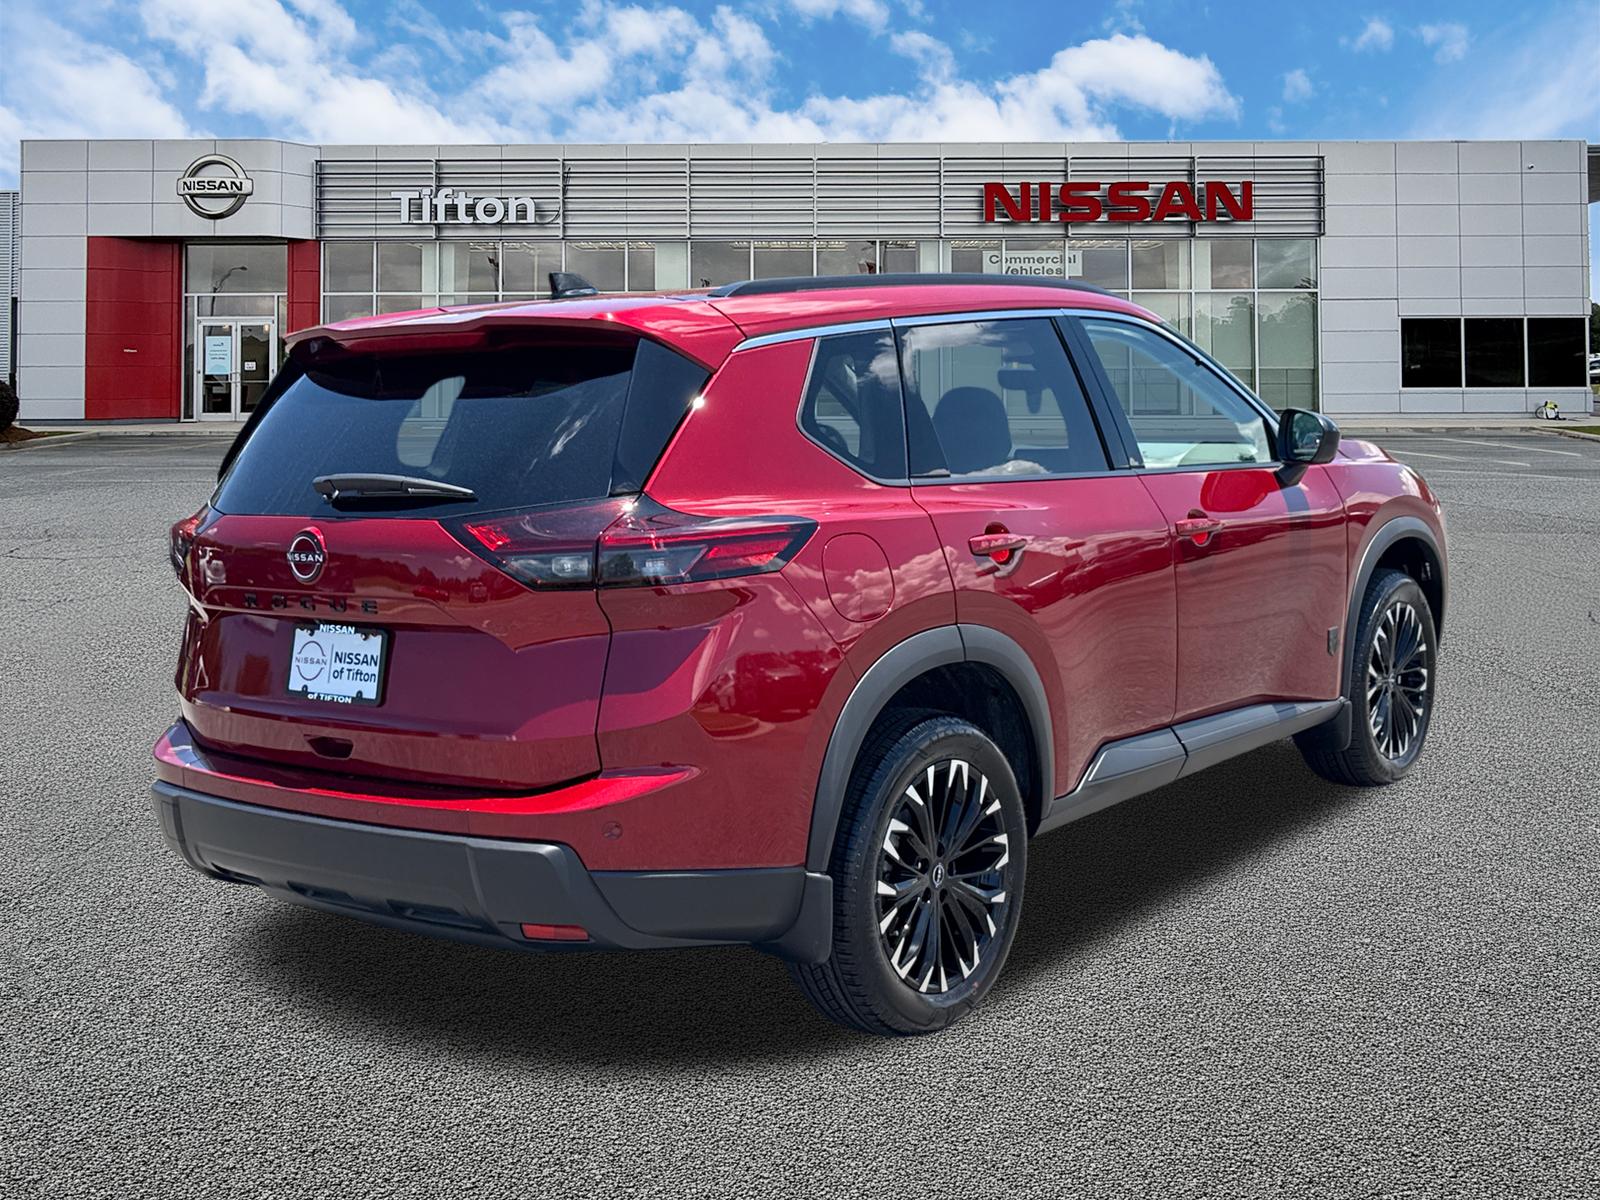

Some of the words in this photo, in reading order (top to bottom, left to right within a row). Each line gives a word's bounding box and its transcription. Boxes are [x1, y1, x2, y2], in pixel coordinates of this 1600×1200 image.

[183, 181, 243, 191] NISSAN
[391, 188, 536, 223] Tifton
[984, 181, 1253, 222] NISSAN
[287, 553, 323, 562] NISSAN
[320, 624, 355, 634] NISSAN
[295, 656, 327, 666] NISSAN
[334, 651, 378, 667] NISSAN
[332, 667, 344, 680] of
[346, 668, 377, 683] Tifton
[307, 692, 319, 700] of
[319, 693, 352, 704] TIFTON
